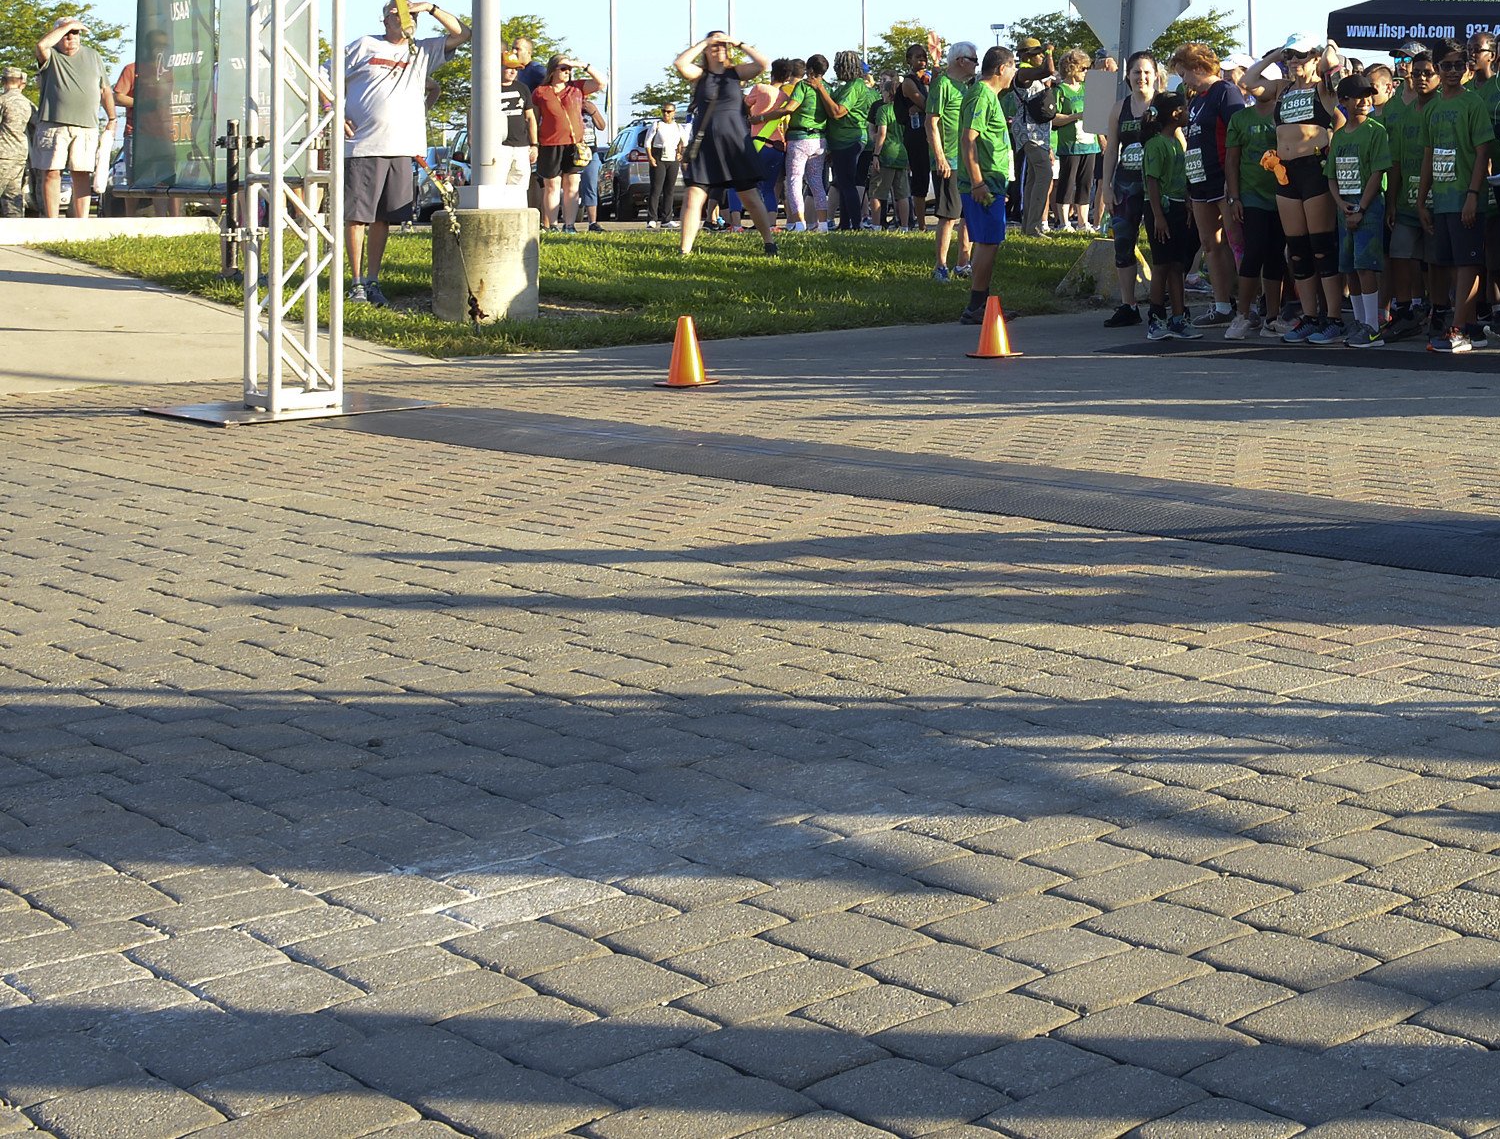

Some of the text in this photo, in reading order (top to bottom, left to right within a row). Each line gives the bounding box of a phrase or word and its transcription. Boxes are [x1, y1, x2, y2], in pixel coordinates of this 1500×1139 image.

[170, 0, 190, 21] USAA
[1346, 23, 1456, 40] www.ihsp-oh.com
[167, 50, 204, 68] BOEING
[1283, 96, 1312, 111] 13861
[171, 113, 193, 142] 5K
[1186, 160, 1202, 171] 4239
